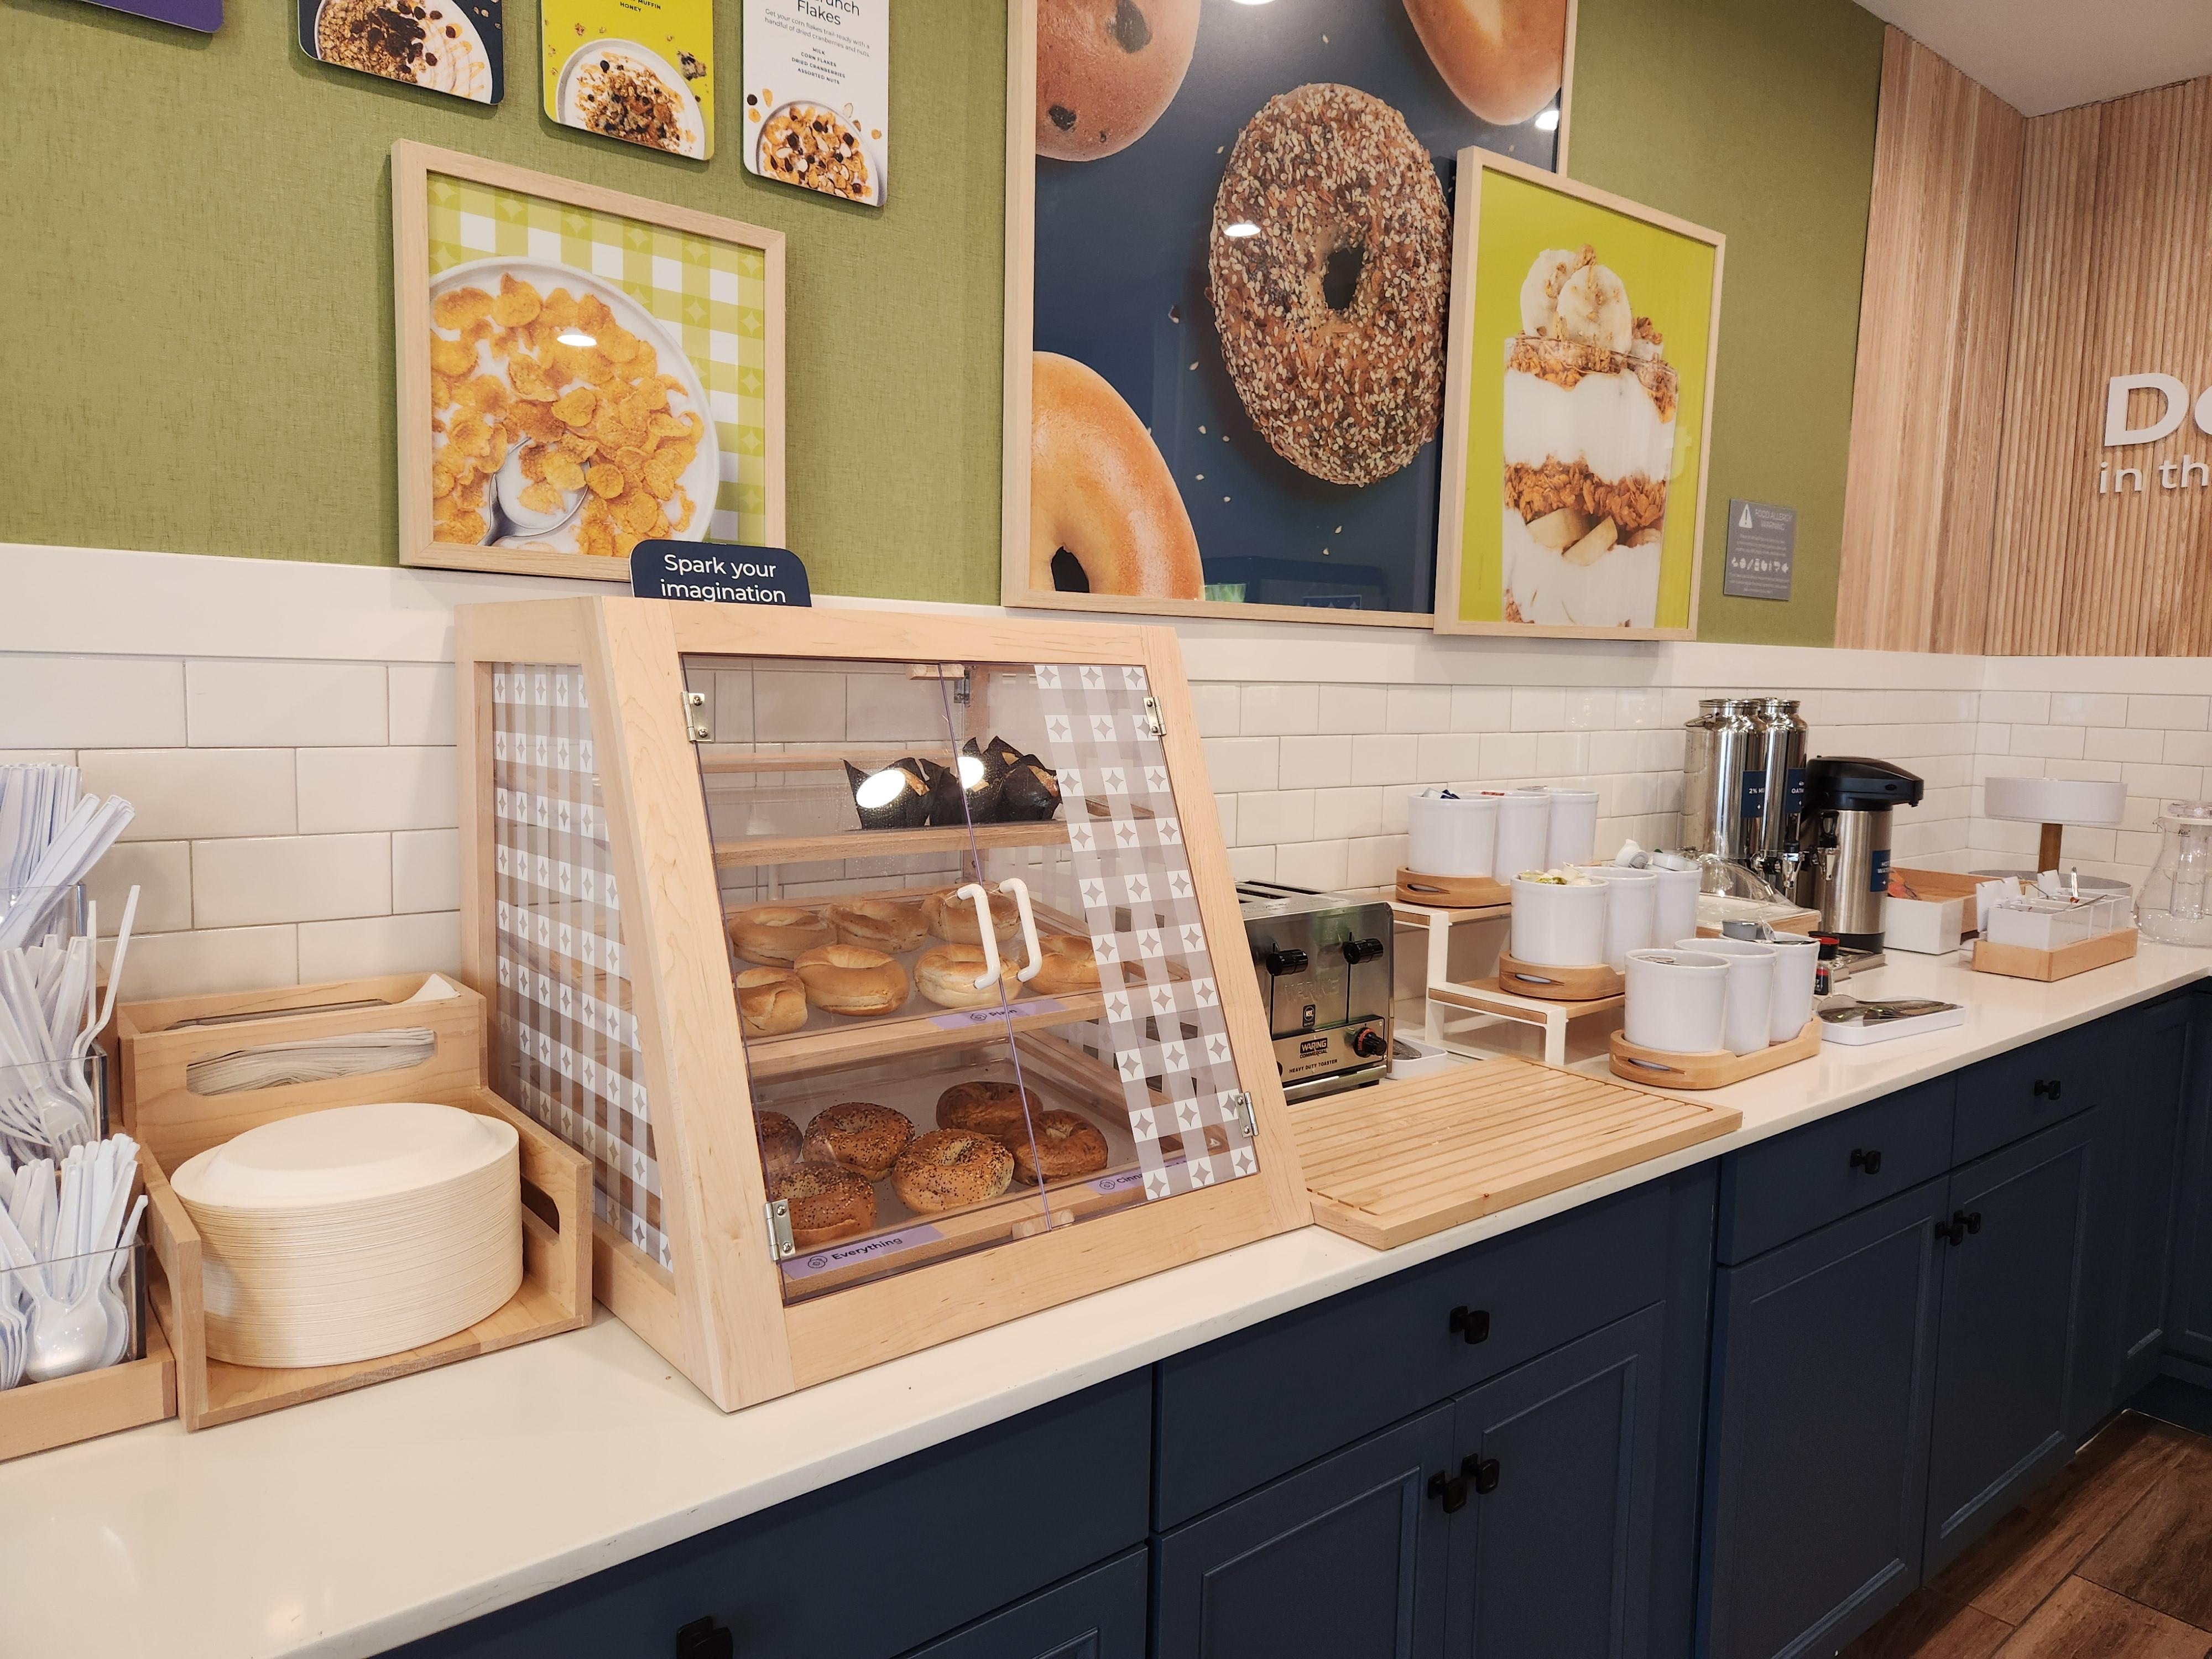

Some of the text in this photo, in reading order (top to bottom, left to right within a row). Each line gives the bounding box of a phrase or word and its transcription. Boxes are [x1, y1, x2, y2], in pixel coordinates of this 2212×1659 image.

[620, 2, 641, 12] HONEY
[797, 0, 841, 25] Flakes
[815, 0, 859, 16] unch
[765, 9, 775, 17] Get
[777, 13, 790, 22] your
[792, 18, 805, 27] corn
[806, 22, 823, 33] flakes
[765, 17, 787, 29] handful
[796, 28, 811, 38] dried
[791, 57, 846, 79] DRIED CRANBERRIES
[801, 52, 837, 67] CORN FLAKES
[797, 68, 825, 80] ASSORTED
[2100, 462, 2143, 493] in
[664, 554, 776, 579] Spark your
[660, 578, 786, 603] imagination
[1300, 1049, 1328, 1059] COMMERCIAL
[1301, 1040, 1327, 1052] WARING
[1318, 1059, 1338, 1067] TOASTER
[831, 1238, 902, 1260] Everything
